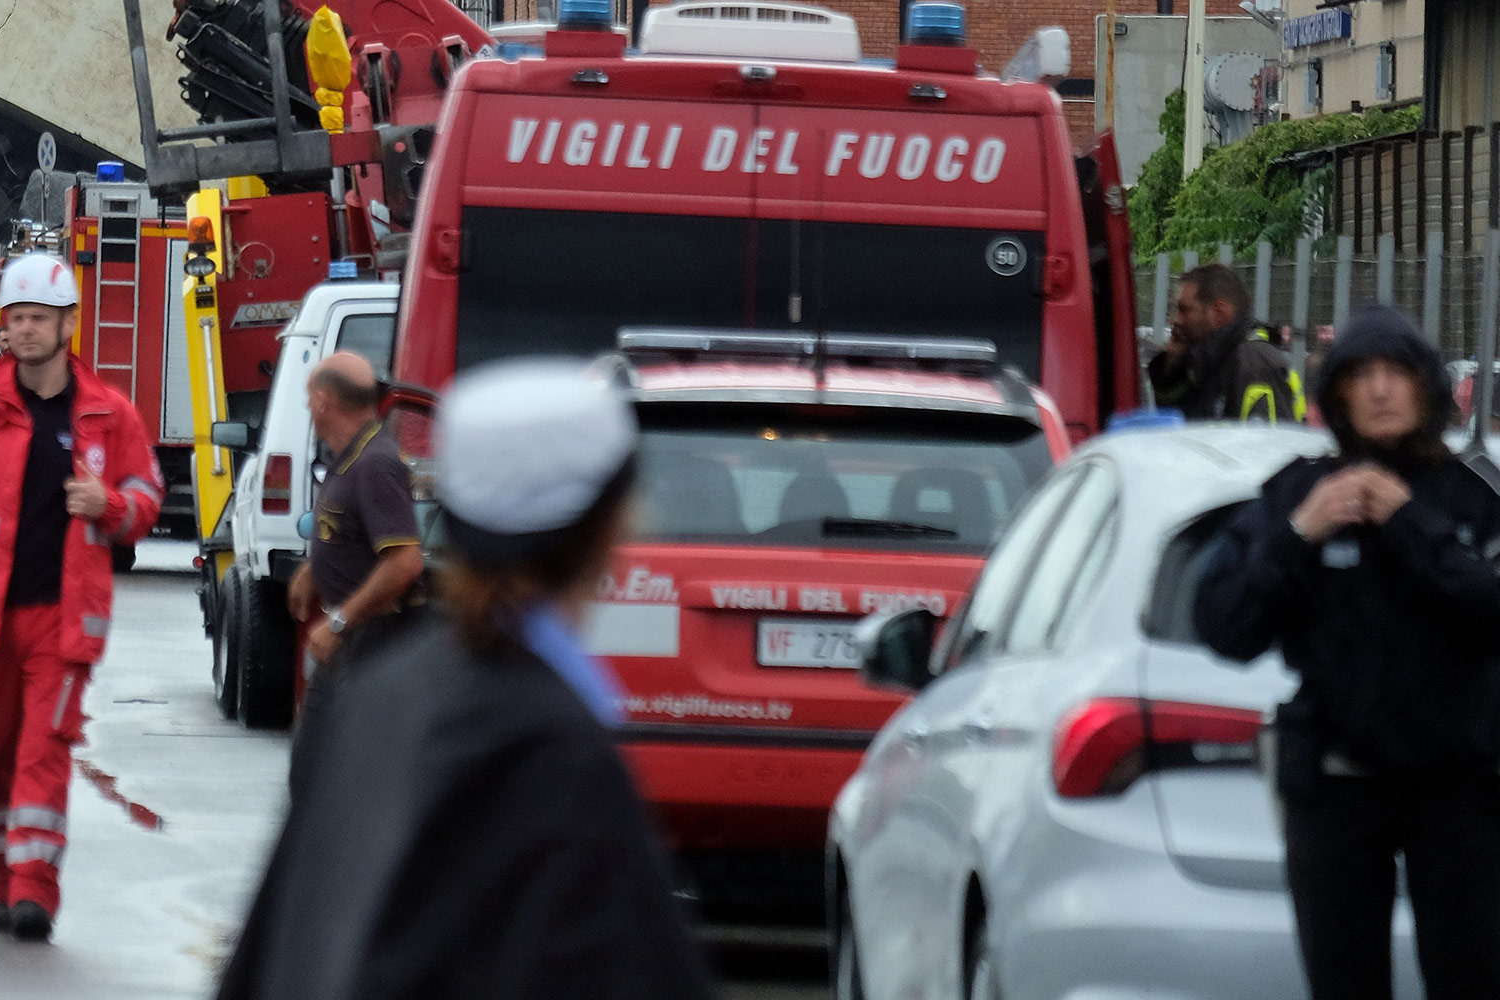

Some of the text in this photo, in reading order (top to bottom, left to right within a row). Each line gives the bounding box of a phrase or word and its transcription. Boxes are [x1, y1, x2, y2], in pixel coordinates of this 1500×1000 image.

[505, 117, 1007, 184] VIGILI DEL FUOCO
[710, 587, 787, 611] VIGILI
[798, 589, 848, 613] DEL
